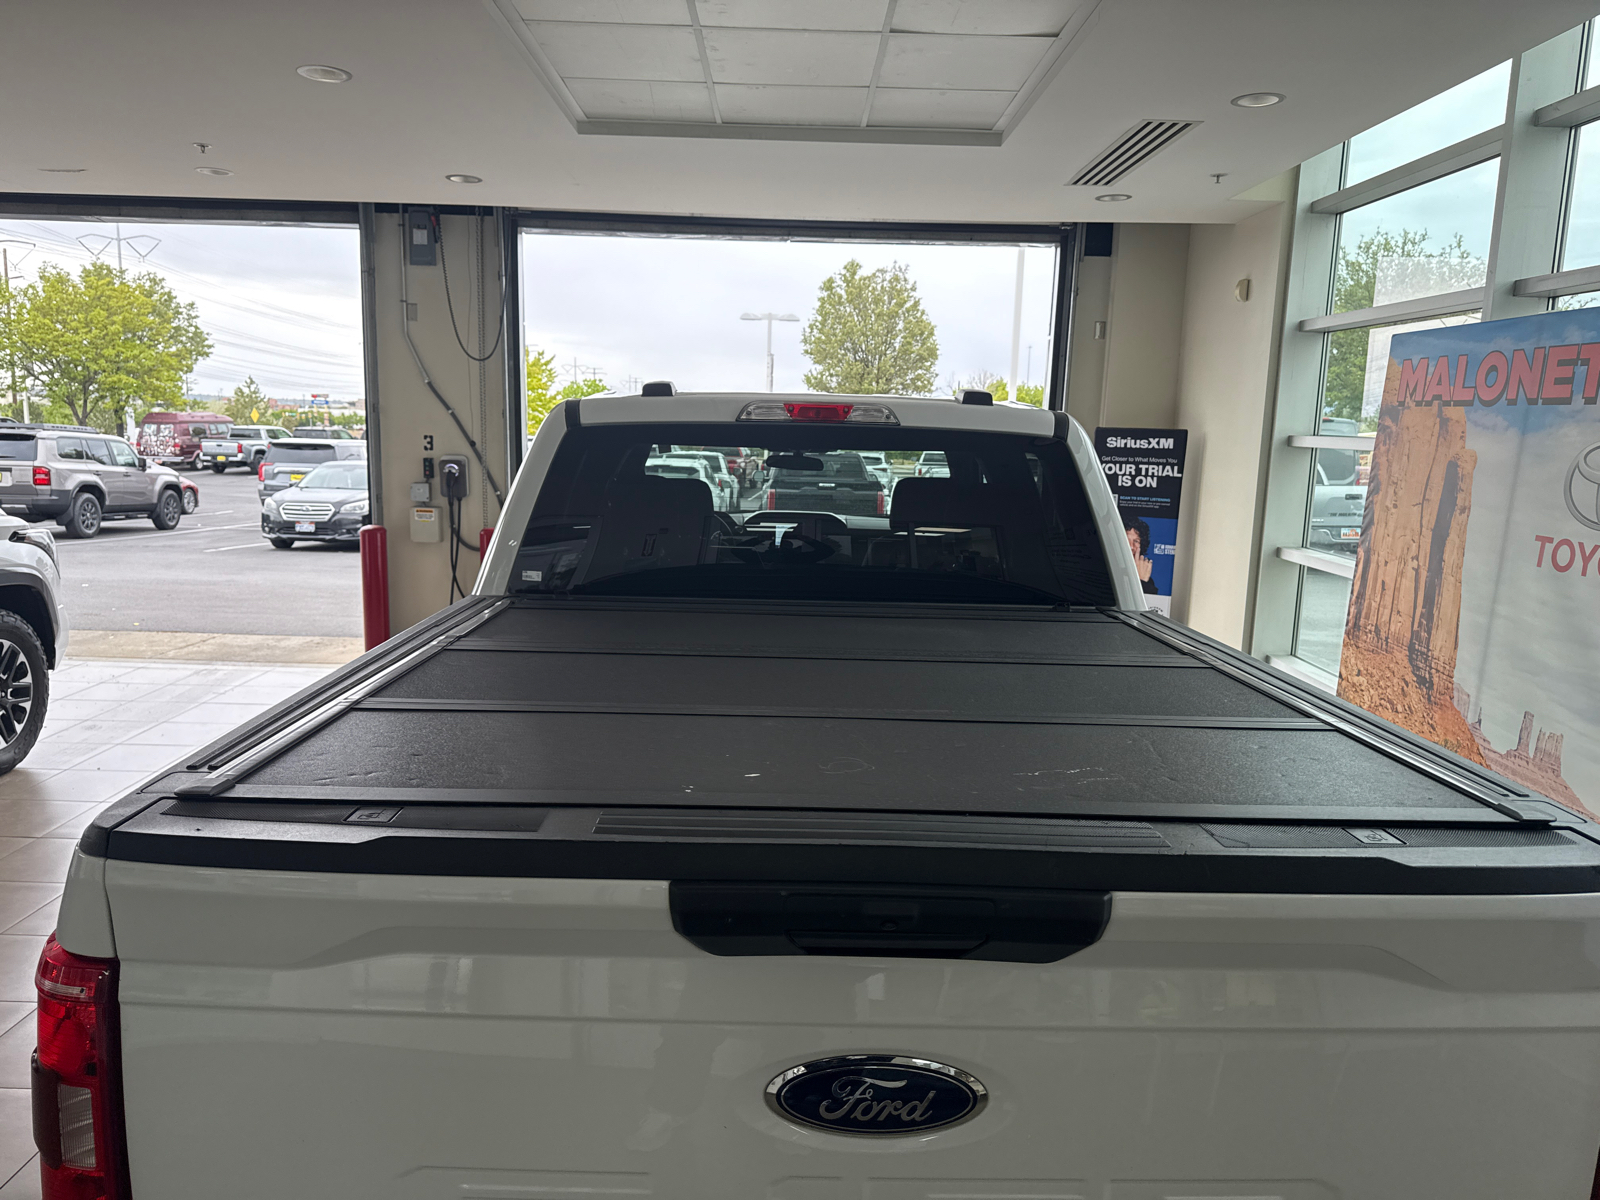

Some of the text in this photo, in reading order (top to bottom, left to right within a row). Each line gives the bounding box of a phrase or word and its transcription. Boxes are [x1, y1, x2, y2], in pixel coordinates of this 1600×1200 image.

[423, 434, 434, 451] 3
[1106, 436, 1174, 449] SiriusXM
[1139, 464, 1182, 478] TRIAL
[1118, 475, 1158, 488] IS ON
[1534, 534, 1600, 577] TOY
[819, 1076, 937, 1122] Ford
